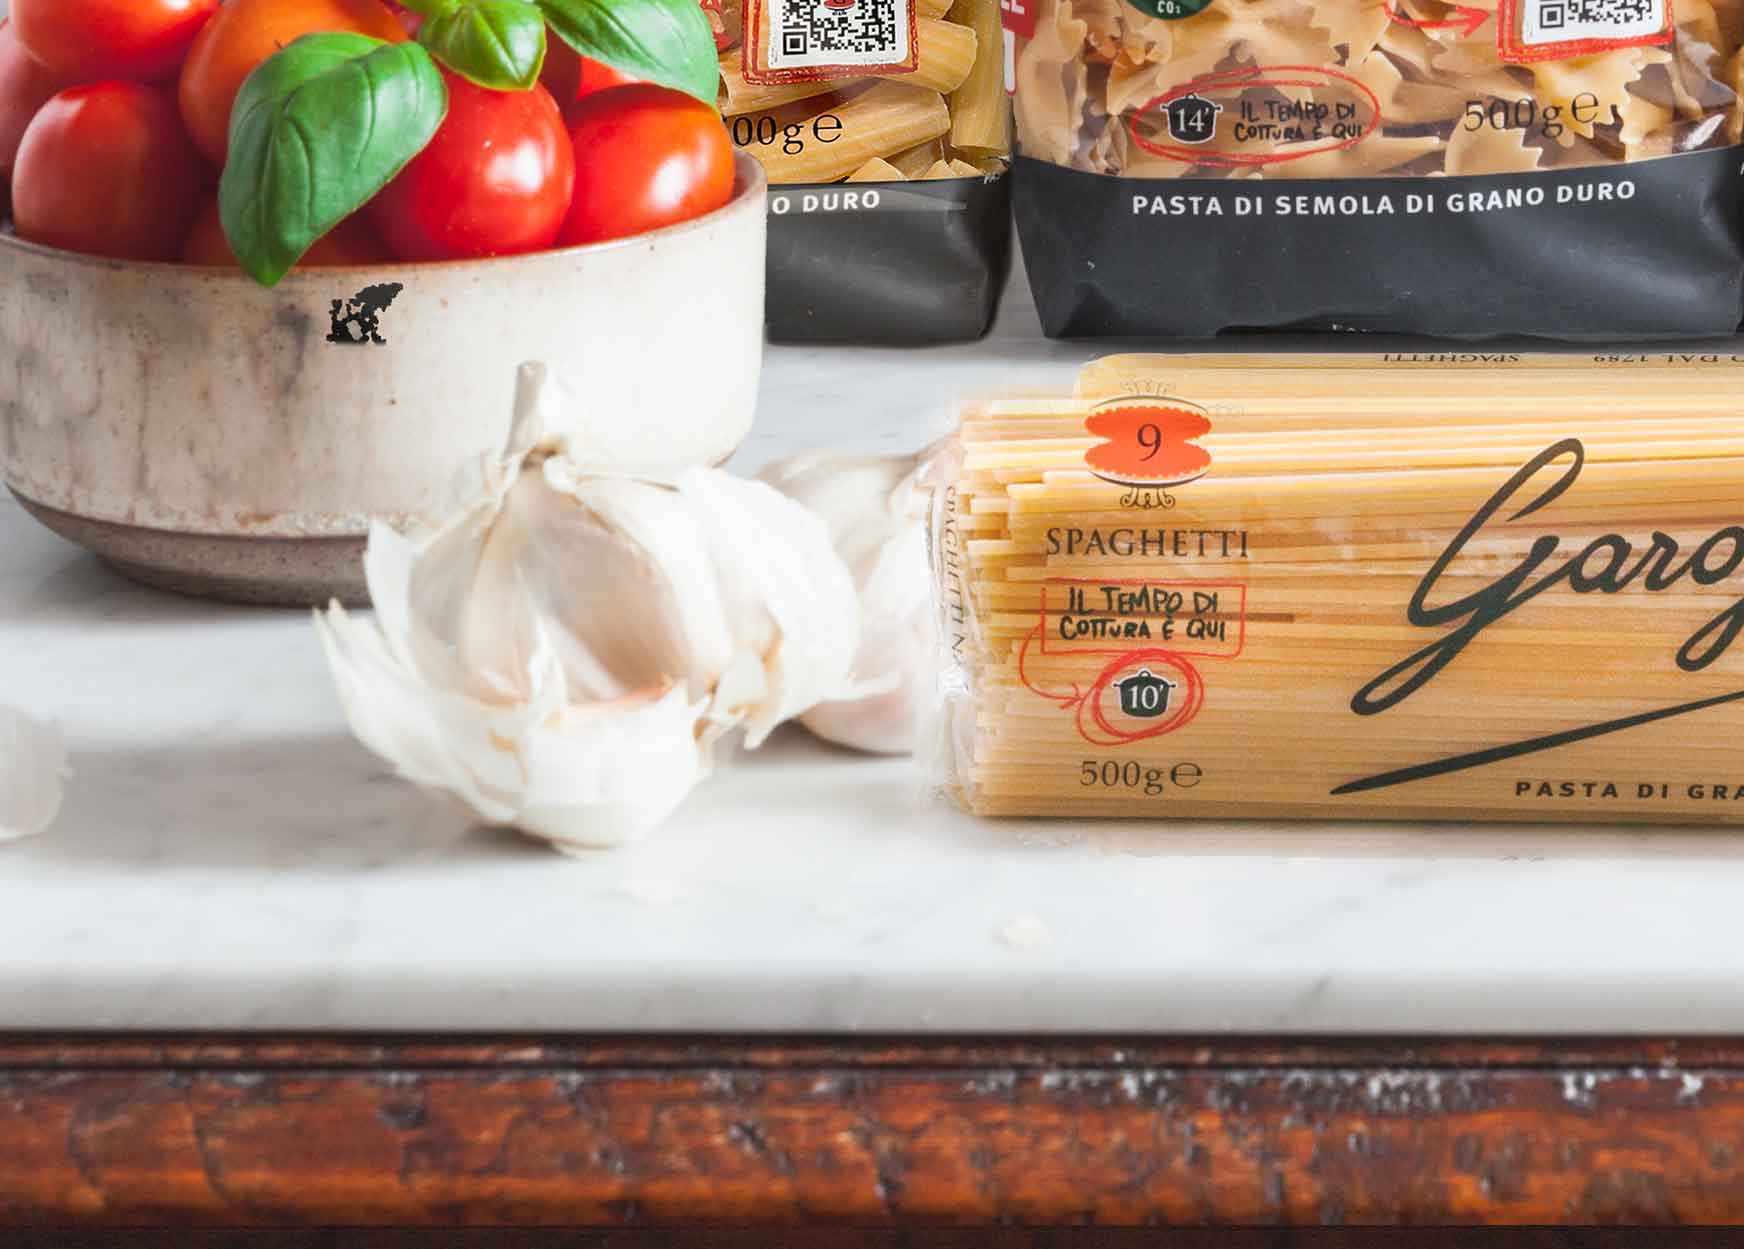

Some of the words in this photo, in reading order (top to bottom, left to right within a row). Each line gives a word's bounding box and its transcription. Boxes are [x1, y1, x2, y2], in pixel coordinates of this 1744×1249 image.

[1241, 101, 1260, 122] IL
[1269, 99, 1329, 123] TEMPO
[1336, 100, 1356, 121] DI
[1463, 96, 1561, 139] 500g
[726, 116, 804, 155] 00g
[1234, 121, 1304, 143] COTTURA
[1331, 124, 1364, 141] QUI
[802, 189, 881, 213] DURO
[1132, 194, 1224, 216] PASTA
[1235, 196, 1263, 216] DI
[1275, 195, 1395, 216] SEMOLA
[1406, 193, 1436, 214] DI
[1446, 186, 1545, 213] GRANO
[1556, 180, 1636, 205] DURO
[1136, 422, 1162, 462] 9
[1046, 527, 1249, 558] SPAGHETTI
[1069, 586, 1094, 616] IL
[1099, 583, 1183, 616] TEMPO
[1192, 591, 1218, 613] DI
[1059, 616, 1151, 641] COTTURA
[1186, 618, 1225, 642] QUI
[1079, 760, 1165, 796] 500g
[1514, 781, 1619, 799] PASTA
[1637, 783, 1669, 799] DI
